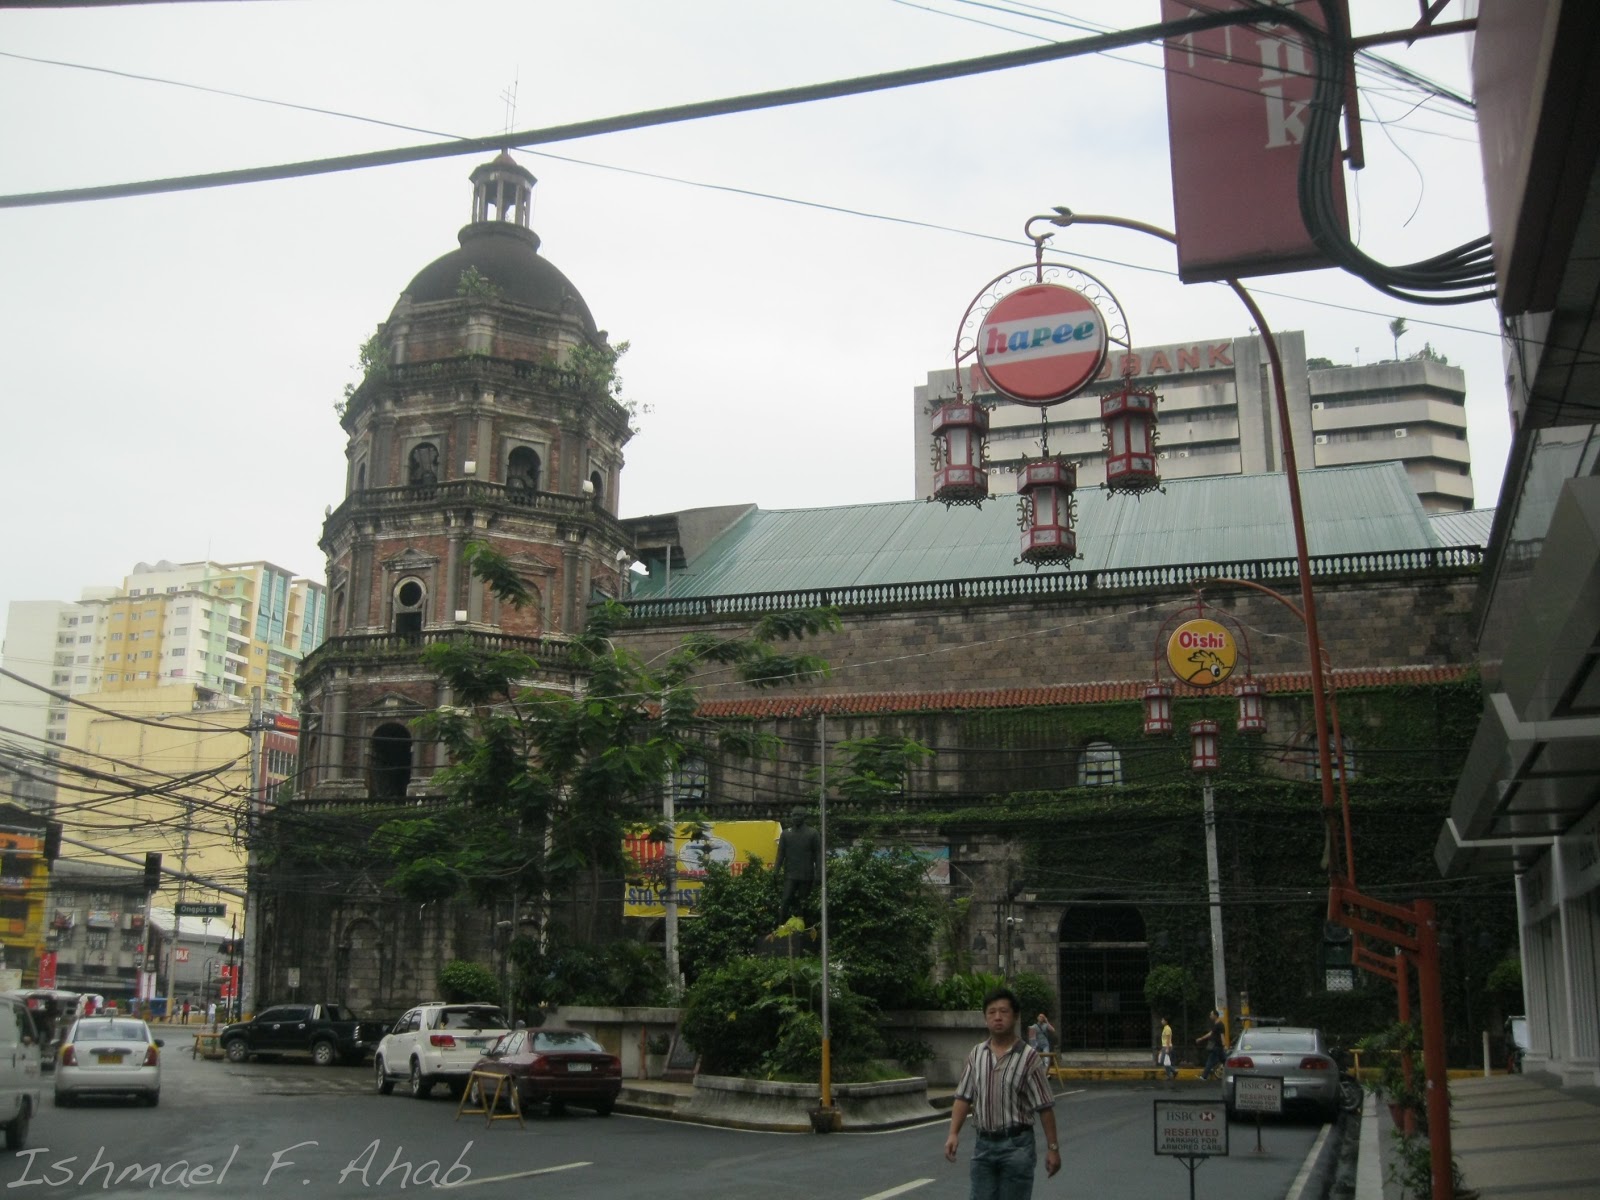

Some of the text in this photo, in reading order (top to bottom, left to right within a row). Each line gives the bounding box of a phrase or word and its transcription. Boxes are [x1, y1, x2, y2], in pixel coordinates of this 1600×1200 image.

[984, 320, 1095, 356] hapee
[1179, 631, 1224, 649] Oishi
[181, 905, 218, 914] Ongpin St
[1166, 1111, 1196, 1121] HSBC
[1164, 1128, 1219, 1137] RESERVED
